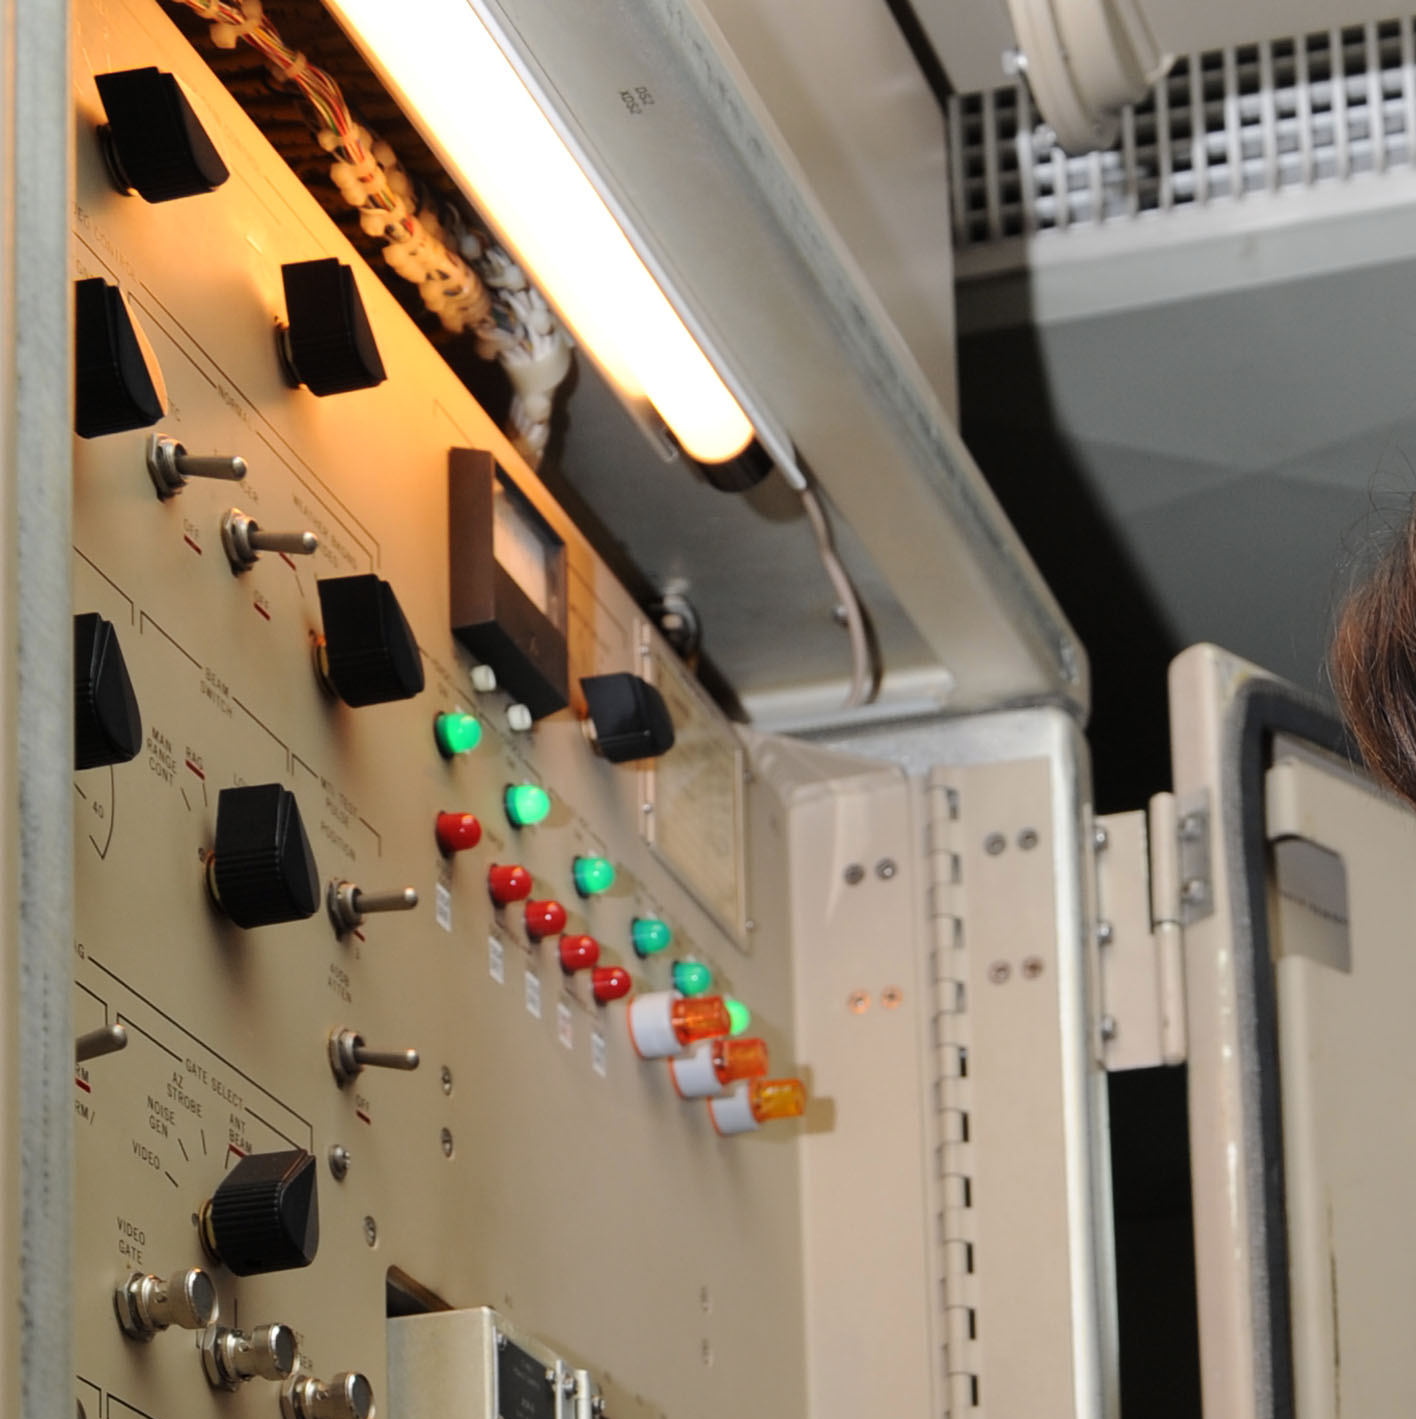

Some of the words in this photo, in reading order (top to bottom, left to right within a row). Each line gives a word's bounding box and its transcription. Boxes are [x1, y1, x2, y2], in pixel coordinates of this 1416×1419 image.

[151, 725, 173, 754] MAN
[147, 737, 178, 775] RANGE
[148, 756, 174, 788] CONT
[171, 1071, 185, 1091] AZ
[185, 1057, 209, 1086] GATE
[210, 1076, 244, 1111] SELECT
[147, 1095, 177, 1127] NOISE
[166, 1083, 204, 1119] STROBE
[148, 1114, 170, 1139] GEN
[228, 1112, 247, 1133] ANT
[131, 1139, 161, 1171] VIDEO
[116, 1216, 147, 1246] VIDEO
[118, 1238, 144, 1266] GATE
